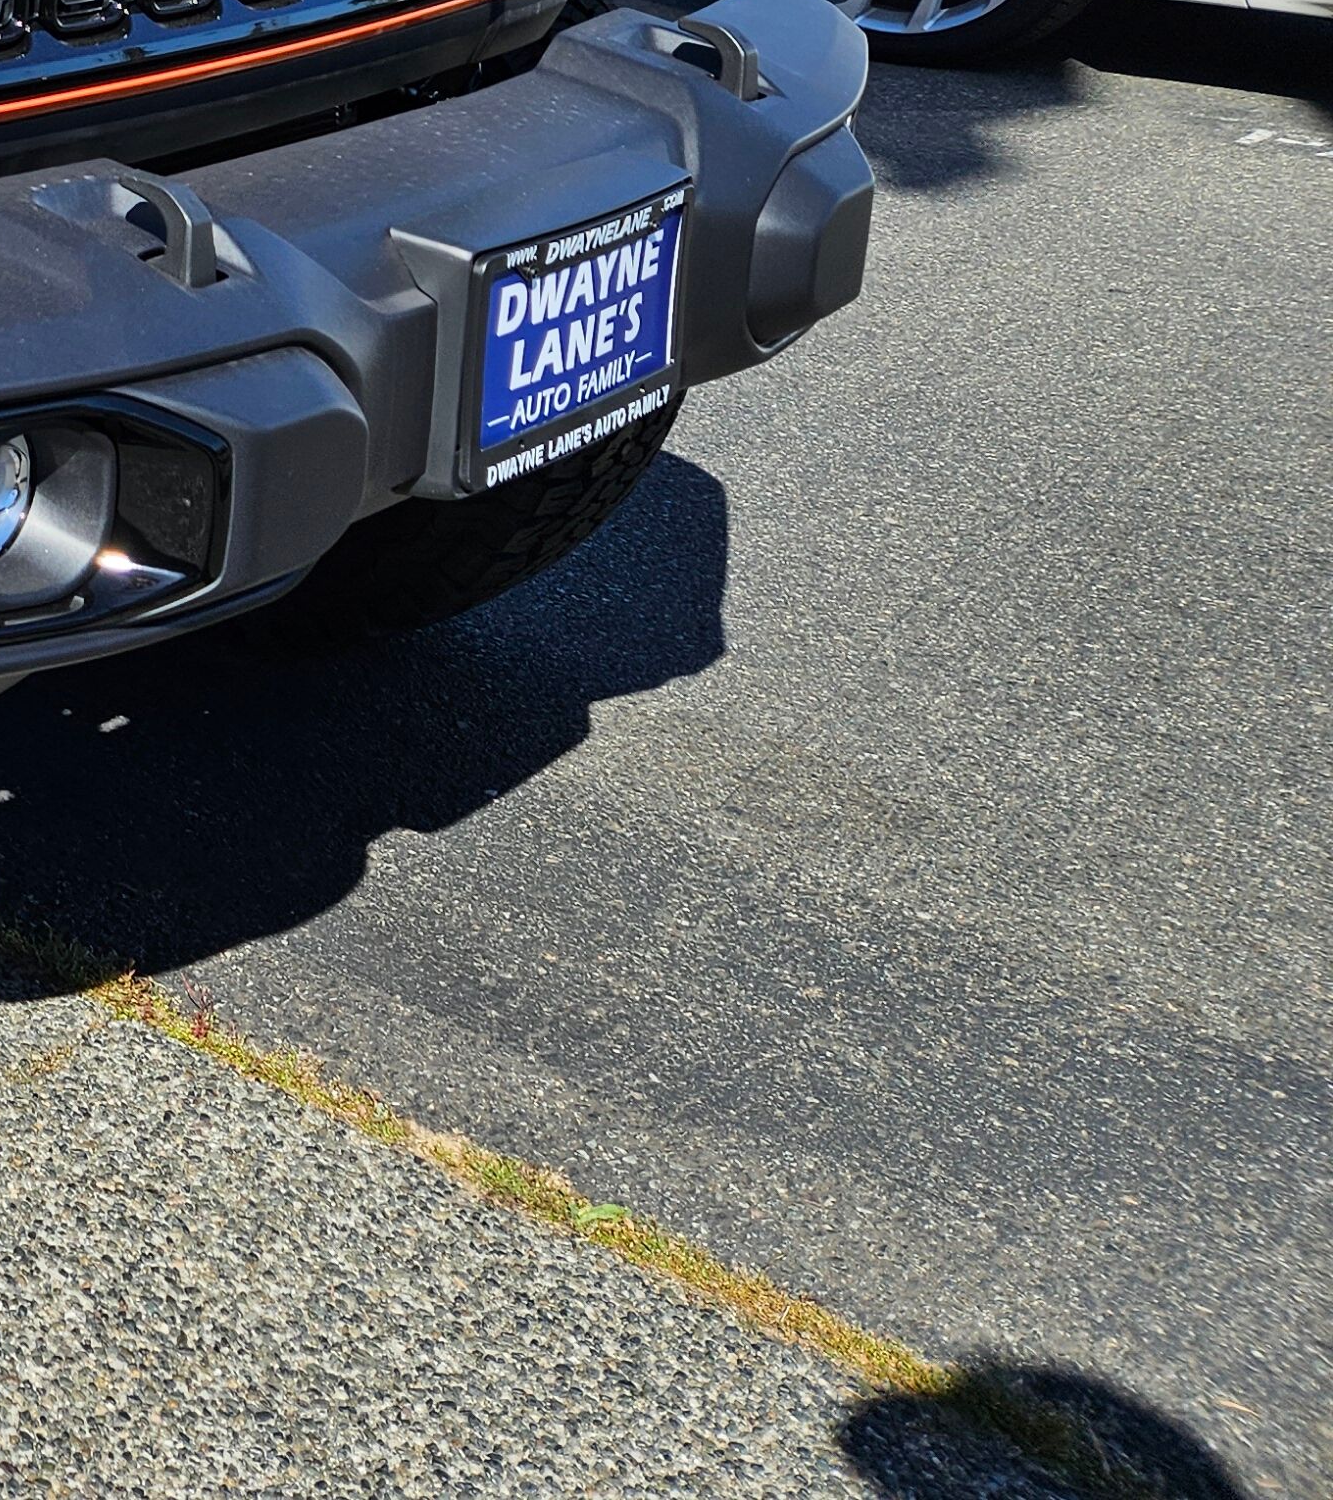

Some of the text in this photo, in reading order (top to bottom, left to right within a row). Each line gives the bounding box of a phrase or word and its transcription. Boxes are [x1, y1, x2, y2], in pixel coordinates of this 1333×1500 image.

[496, 229, 664, 337] DWAYNE
[545, 206, 653, 265] DWAYNELANE
[509, 291, 644, 391] LANE'S
[510, 351, 636, 430] AUTO FAMILY
[486, 384, 671, 489] DWAYNE LANE'S AUTO FAMILY
